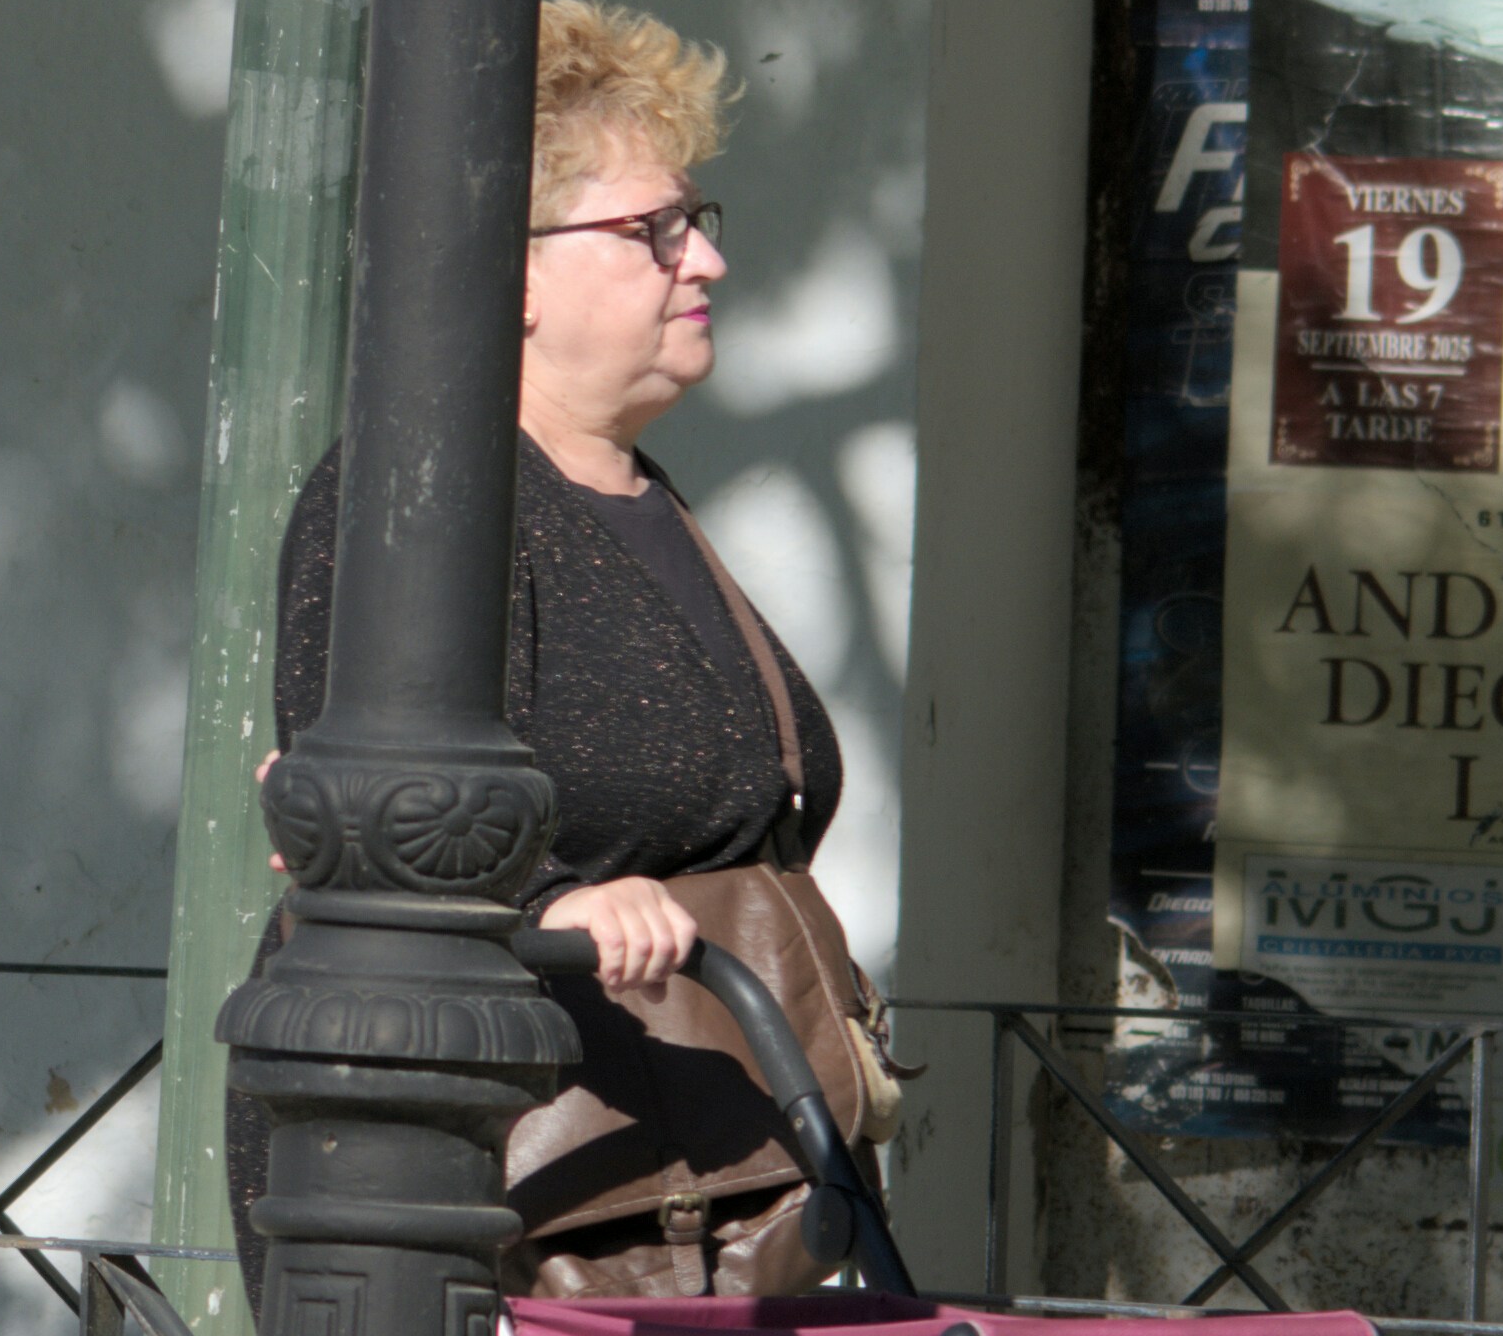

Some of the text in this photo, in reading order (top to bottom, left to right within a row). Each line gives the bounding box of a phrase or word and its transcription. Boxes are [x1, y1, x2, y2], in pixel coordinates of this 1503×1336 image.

[1347, 186, 1465, 215] VIERNES
[1332, 223, 1465, 323] 19
[1297, 330, 1474, 361] SEPTIEMBRE 2025
[1319, 381, 1444, 408] A LAS 7
[1325, 413, 1433, 442] TARDE
